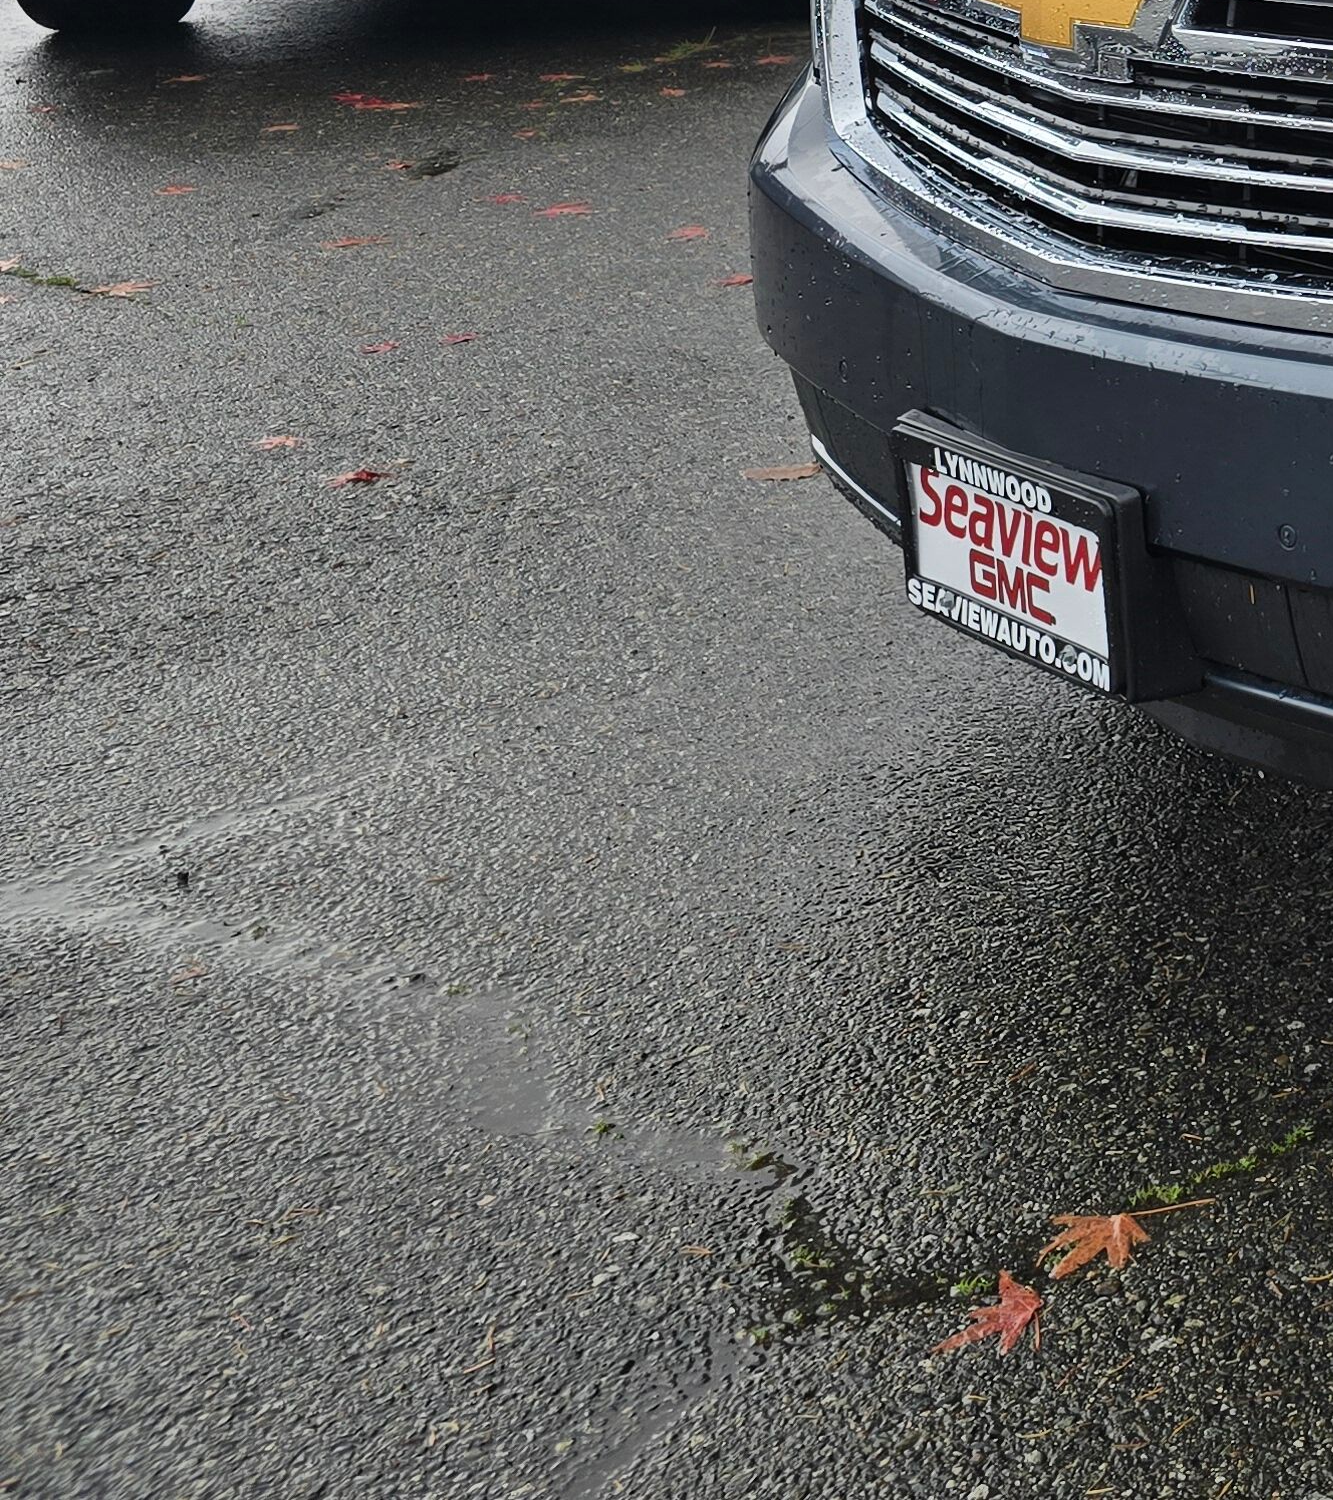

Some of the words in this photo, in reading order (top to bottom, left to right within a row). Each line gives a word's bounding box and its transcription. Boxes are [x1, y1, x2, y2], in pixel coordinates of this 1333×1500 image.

[933, 446, 1053, 514] LYNNWOOD
[918, 467, 1104, 593] Seaview
[968, 547, 1056, 626] GMC
